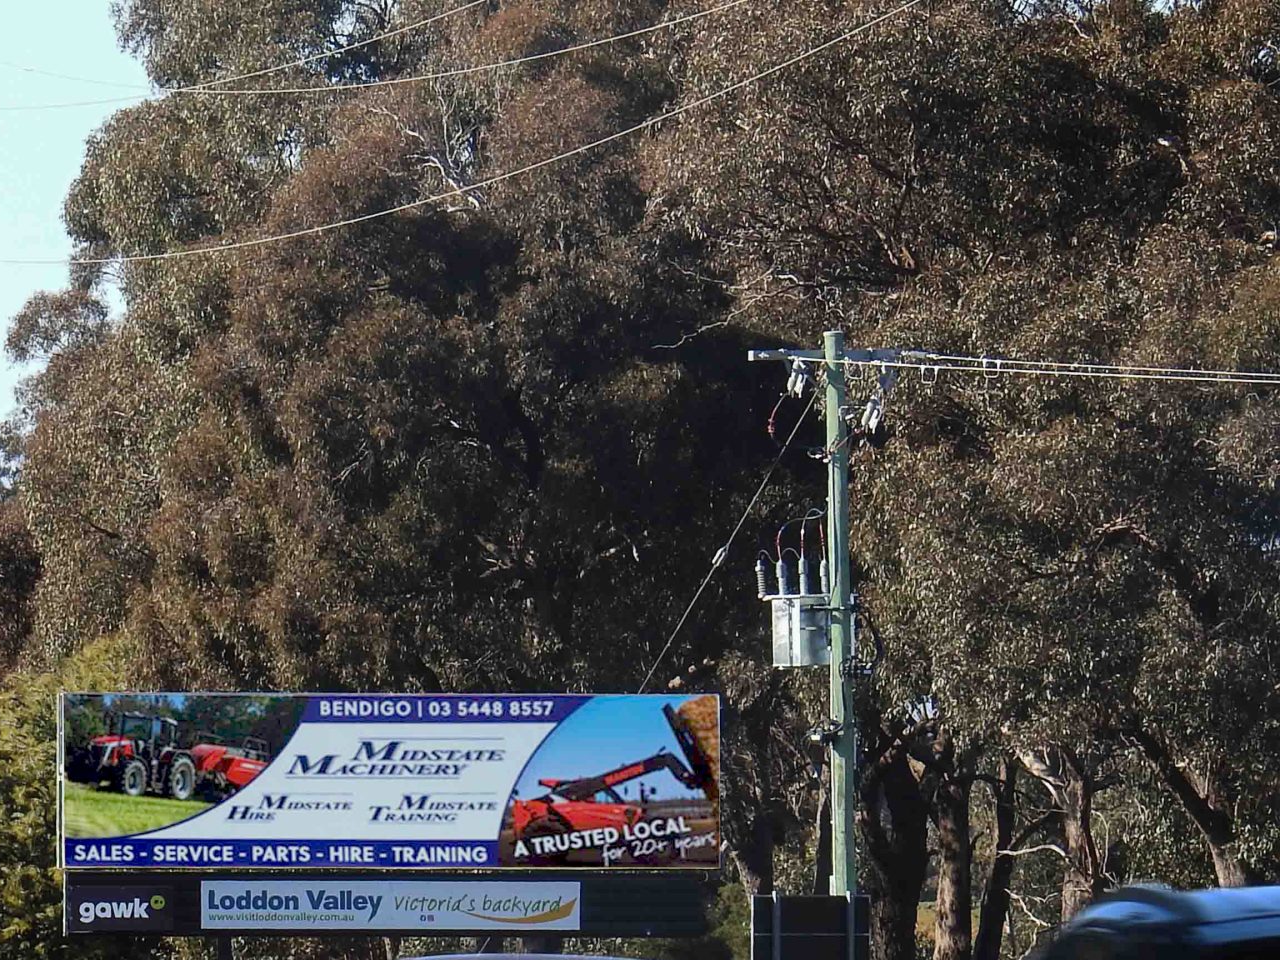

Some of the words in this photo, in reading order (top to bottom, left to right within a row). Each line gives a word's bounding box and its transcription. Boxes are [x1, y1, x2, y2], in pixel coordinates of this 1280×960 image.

[320, 701, 412, 716] BENDIGO
[428, 701, 452, 716] 03
[457, 701, 504, 716] 5448
[509, 701, 554, 716] 8557
[351, 741, 506, 762] MIDSTATE
[285, 755, 469, 776] MACHINERY
[259, 795, 353, 811] MIDSTATE
[397, 795, 498, 812] MIDSTATE
[226, 806, 276, 822] HIRE
[369, 806, 458, 822] TRAINING
[513, 840, 529, 858] A
[531, 827, 619, 853] TRUSTED
[623, 816, 691, 841] LOCAL
[74, 845, 134, 862] SALES
[152, 845, 234, 862] SERVICE
[251, 845, 311, 863] PARTS
[329, 846, 375, 863] HIRE
[391, 846, 488, 863] TRAINING
[602, 843, 627, 867] for
[630, 837, 669, 857] 20+
[674, 832, 717, 859] years
[79, 898, 150, 924] gawk
[208, 890, 299, 911] Loddon
[306, 890, 383, 923] Valley
[394, 894, 476, 912] Victoria's
[482, 894, 562, 917] backyard
[208, 912, 355, 923] www.visitloddonvalley.com.au
